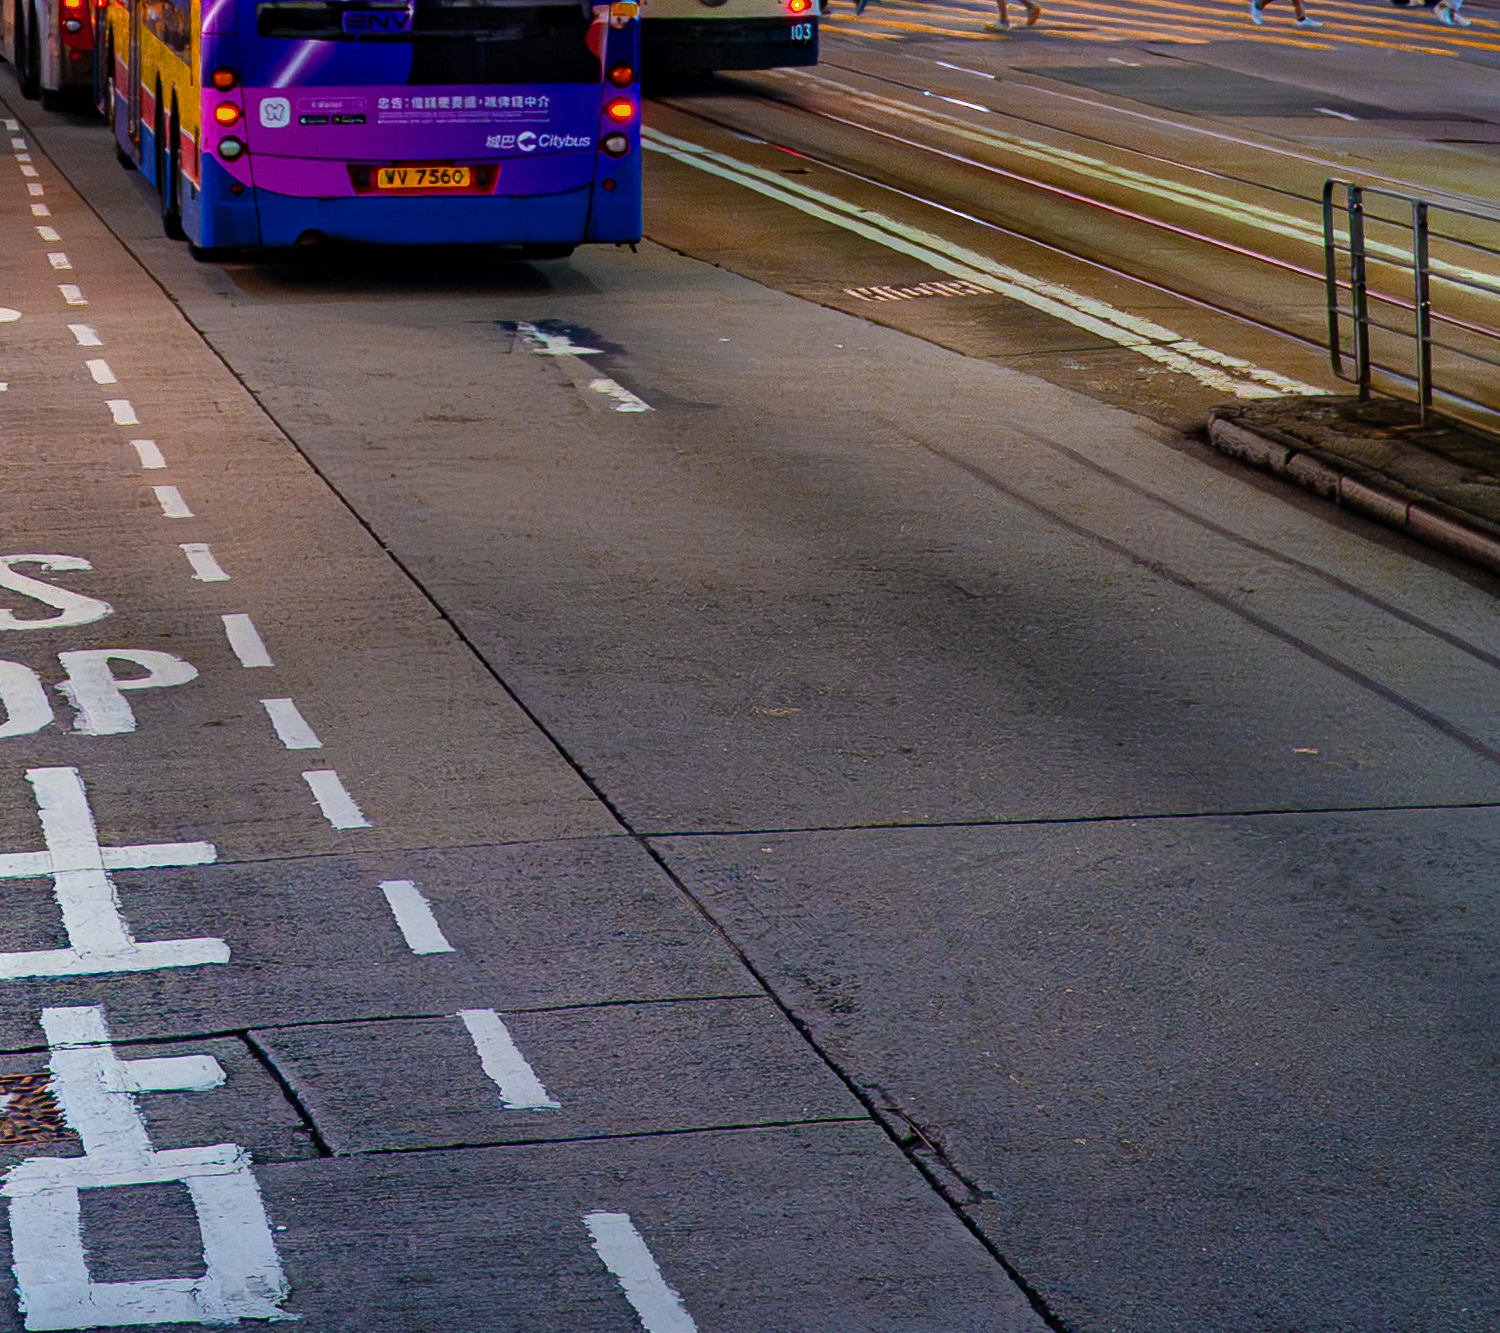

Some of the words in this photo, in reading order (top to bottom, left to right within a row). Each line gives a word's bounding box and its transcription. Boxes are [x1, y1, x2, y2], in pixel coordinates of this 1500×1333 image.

[791, 24, 811, 39] 103
[486, 135, 514, 148] 城巴
[538, 134, 591, 148] Citybus
[416, 170, 464, 183] 7560
